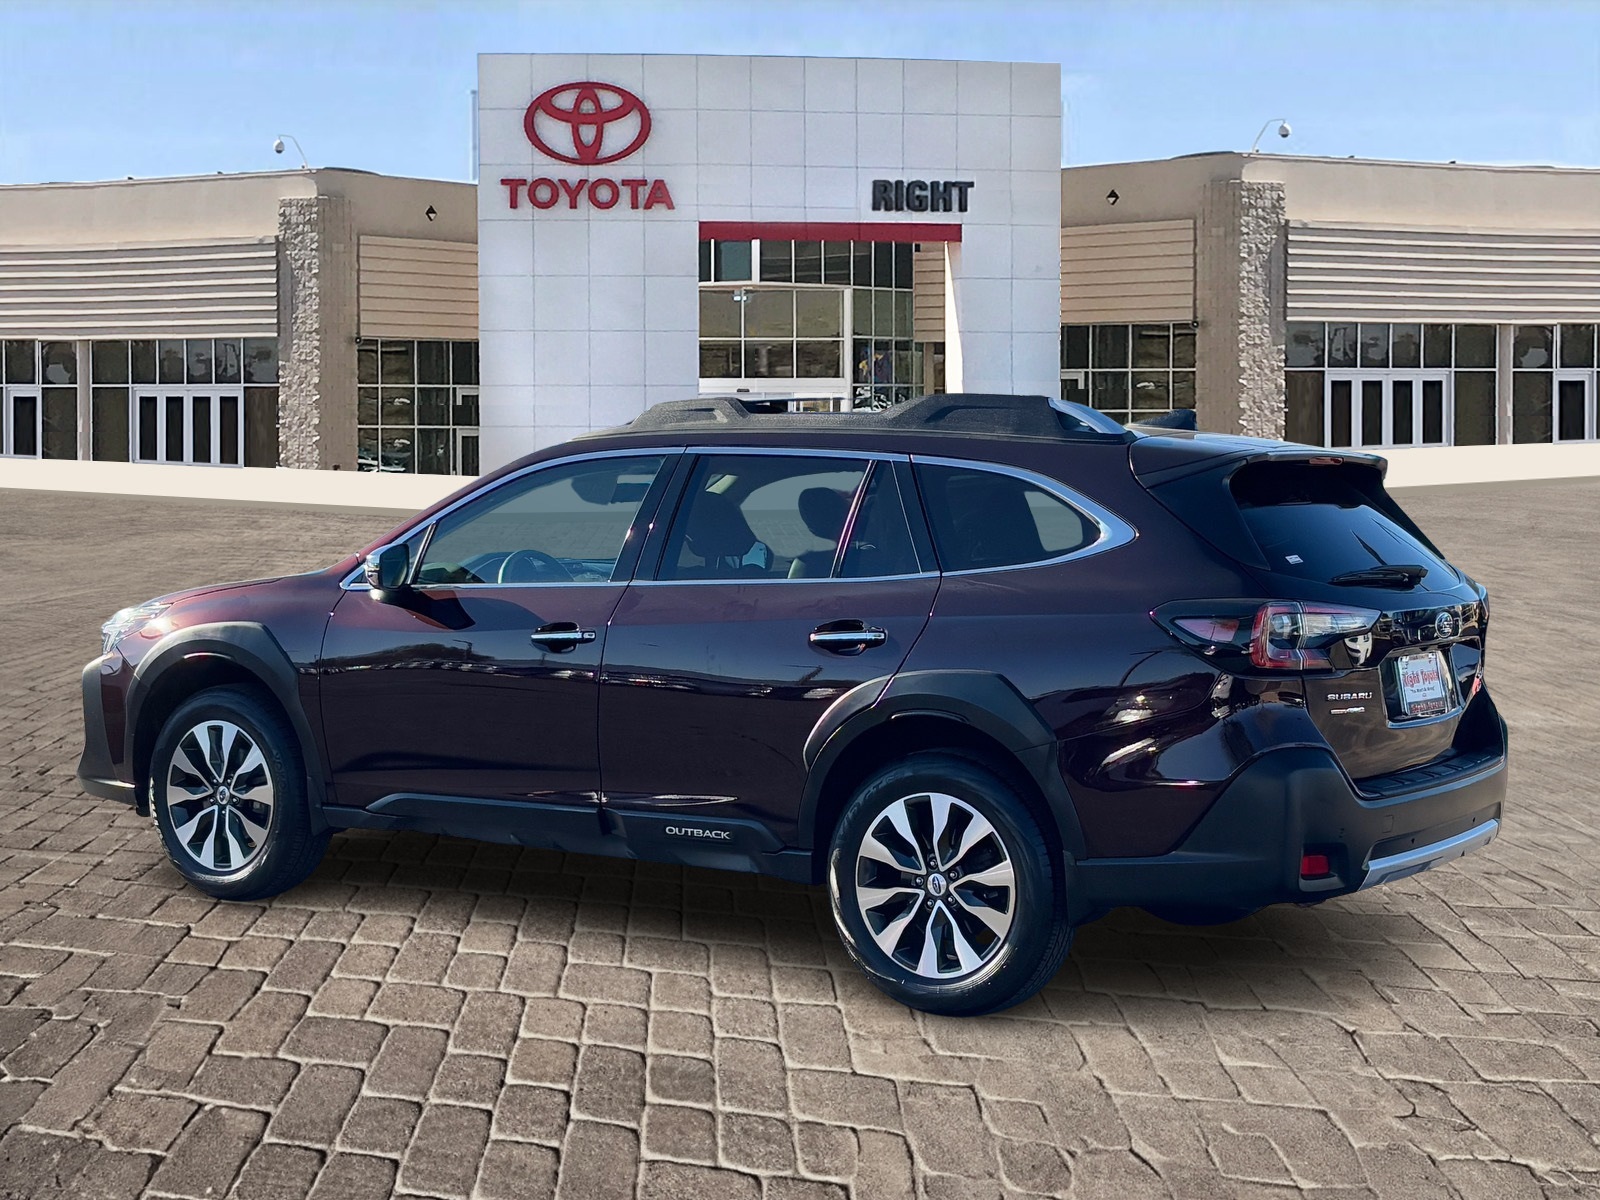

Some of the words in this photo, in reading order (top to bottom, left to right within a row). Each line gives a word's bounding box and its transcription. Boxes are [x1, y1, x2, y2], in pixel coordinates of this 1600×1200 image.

[500, 177, 675, 210] TOYOTA
[872, 179, 975, 212] RIGHT
[1327, 691, 1373, 701] SUBARU
[665, 826, 731, 840] OUTBACK
